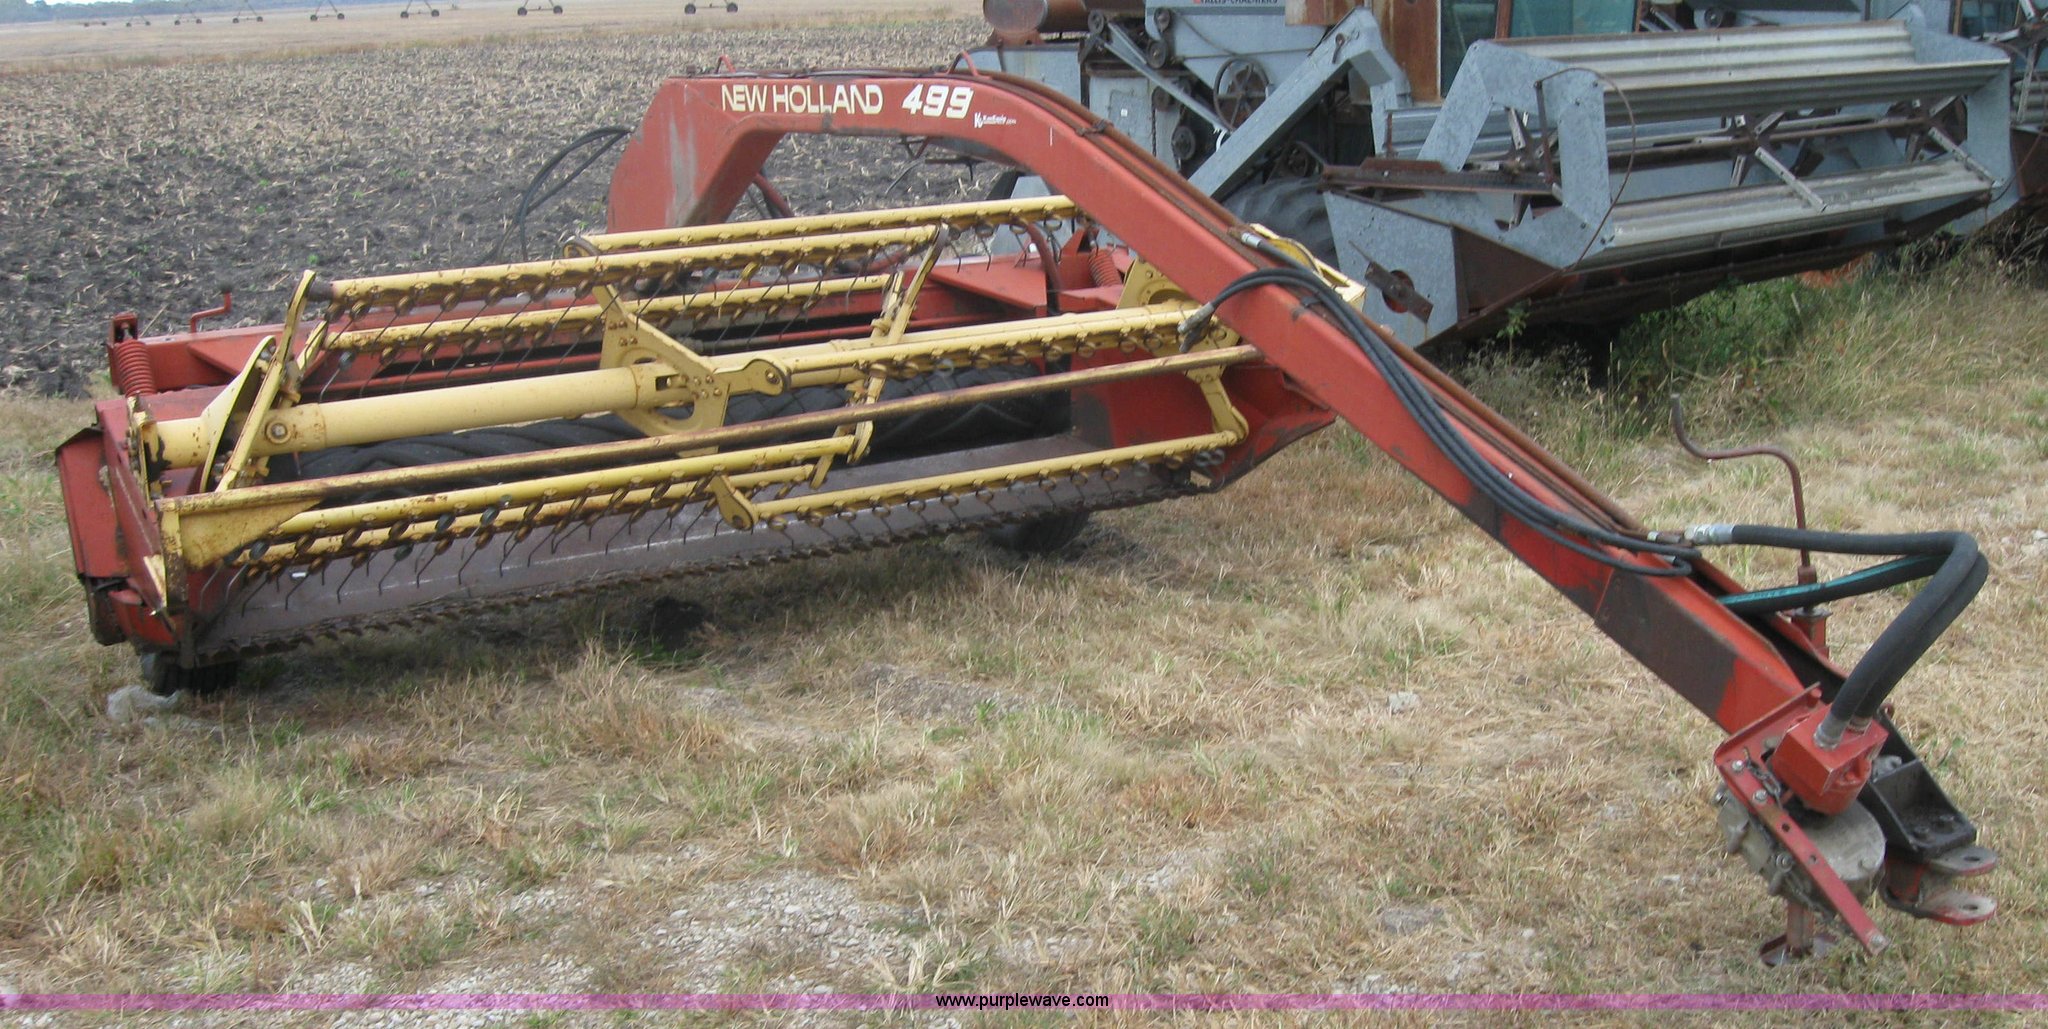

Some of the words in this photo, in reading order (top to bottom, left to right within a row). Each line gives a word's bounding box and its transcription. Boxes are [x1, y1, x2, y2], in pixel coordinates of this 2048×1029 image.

[721, 84, 767, 112] NEW
[773, 84, 883, 115] HOLLAND
[902, 84, 975, 118] 499
